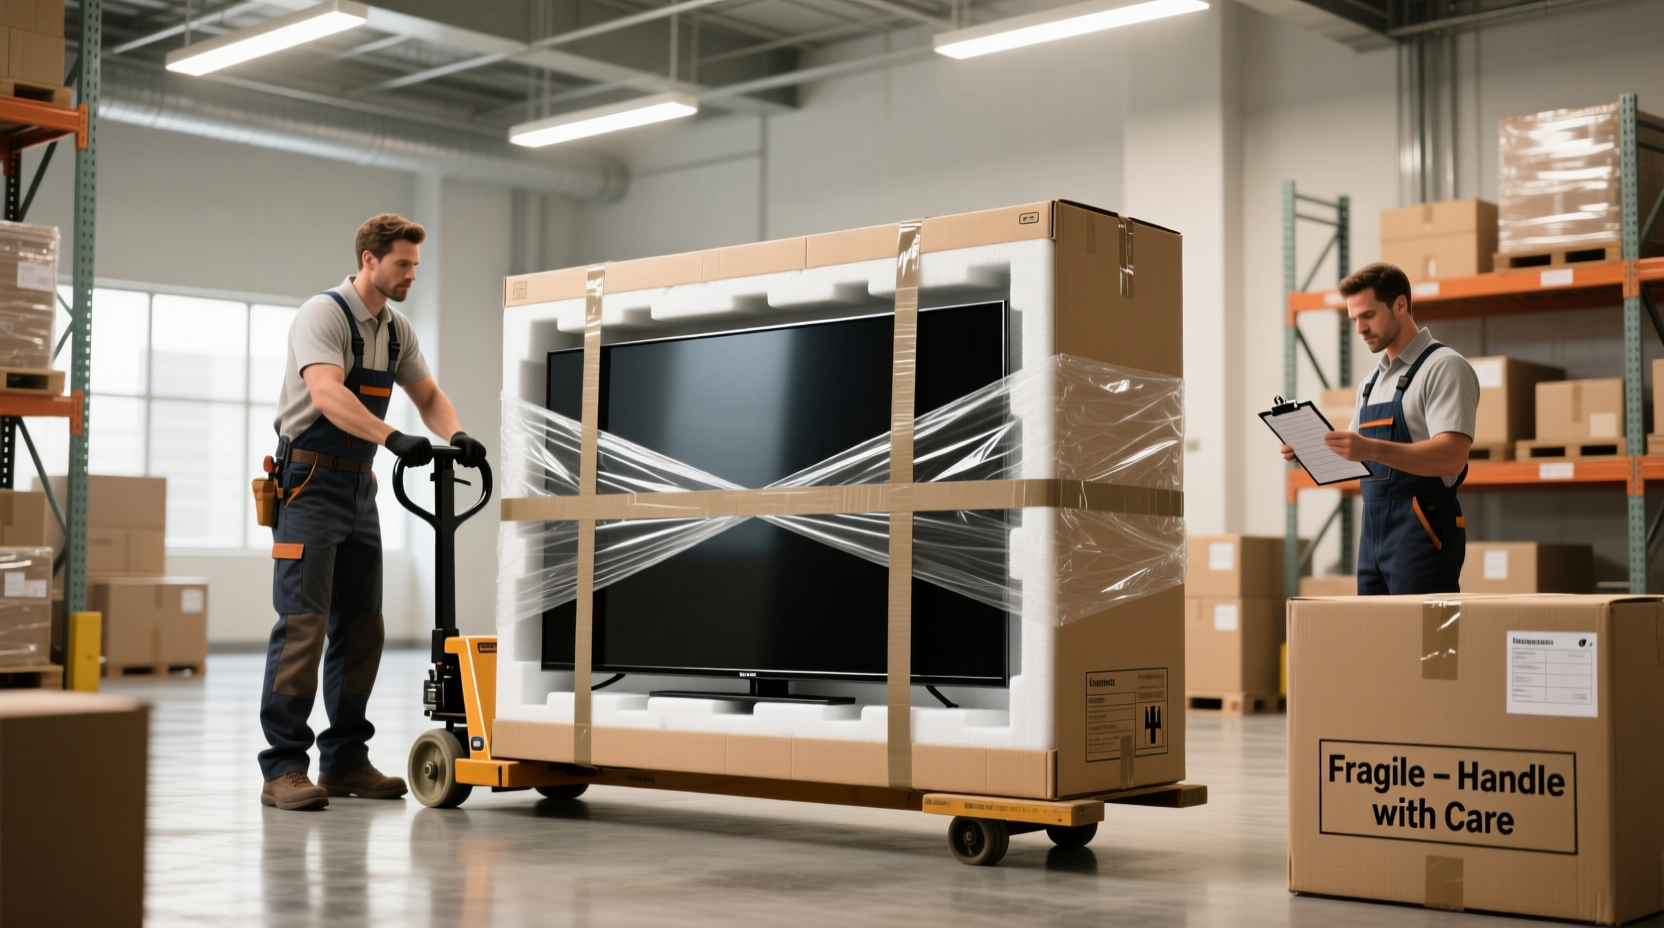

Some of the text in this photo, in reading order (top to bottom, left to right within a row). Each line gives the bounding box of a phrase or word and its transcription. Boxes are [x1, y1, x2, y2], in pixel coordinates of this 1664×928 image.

[1329, 754, 1425, 794] Fragile
[1458, 760, 1566, 797] Handle
[1372, 797, 1515, 836] with Care
